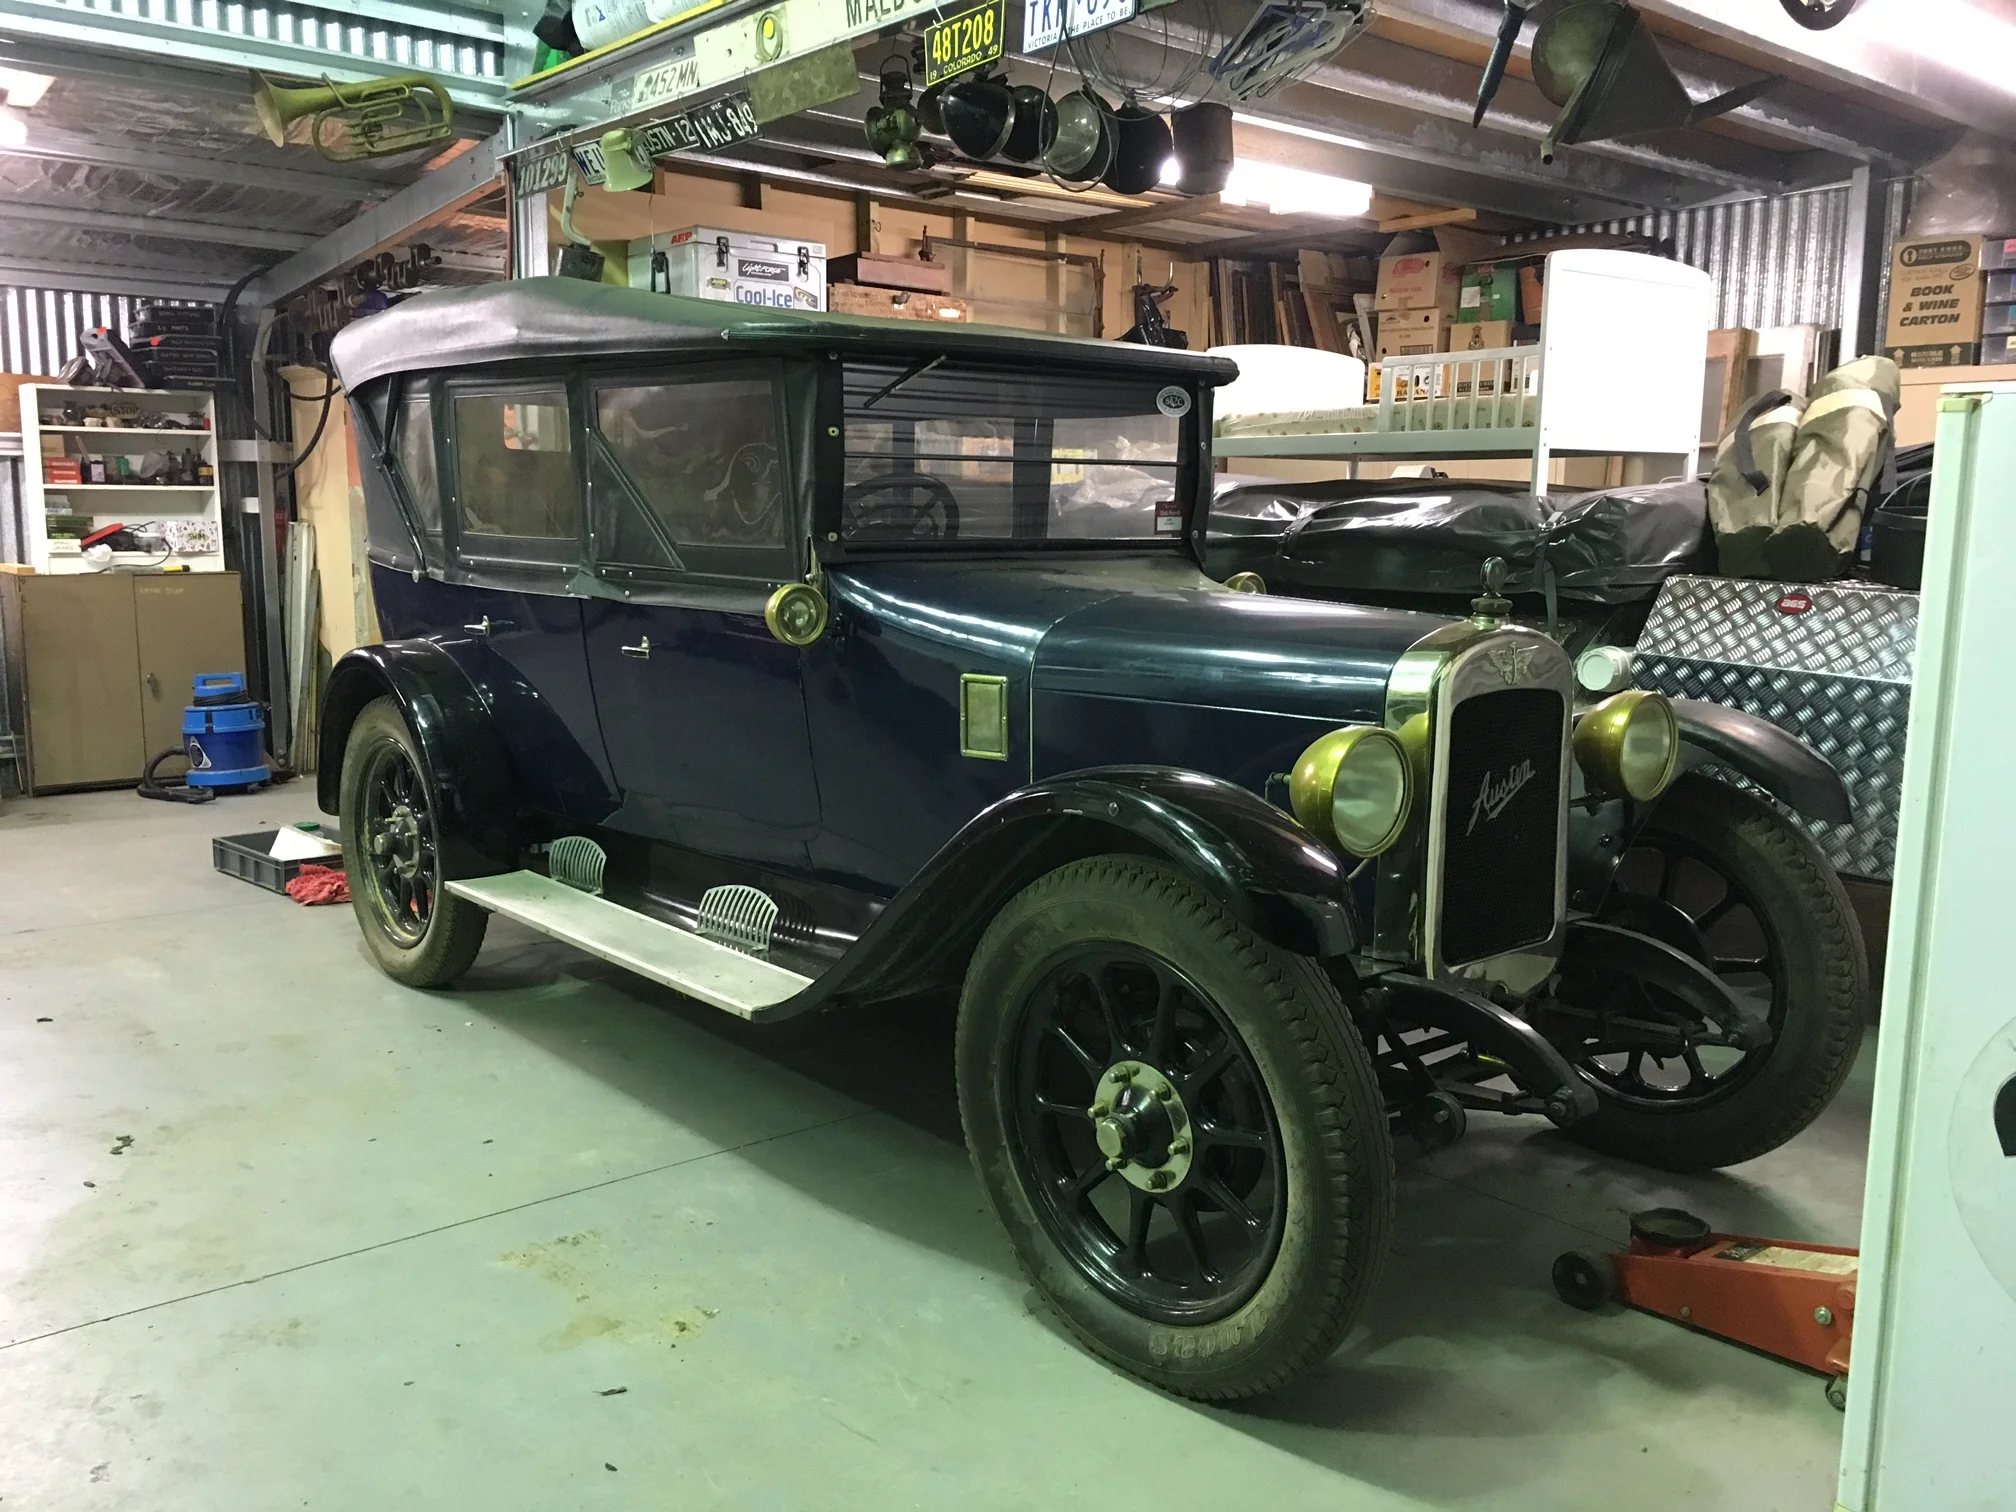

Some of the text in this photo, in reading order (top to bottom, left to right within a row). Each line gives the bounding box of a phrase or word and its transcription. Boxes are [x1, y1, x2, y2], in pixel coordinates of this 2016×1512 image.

[932, 9, 994, 65] 48T208
[1027, 35, 1057, 49] VICTORIA
[1067, 24, 1079, 34] THE
[1083, 15, 1103, 29] PLACE
[1107, 11, 1116, 20] TO
[930, 44, 998, 80] 19 COLORADO 49
[710, 102, 723, 110] VIC
[518, 152, 568, 195] 101299
[736, 285, 792, 308] Cool-Ice
[1910, 284, 1955, 297] BOOK
[1902, 298, 1960, 312] & WINE
[1899, 313, 1961, 327] CARTON
[113, 405, 139, 415] STOP
[1466, 758, 1536, 837] Austin
